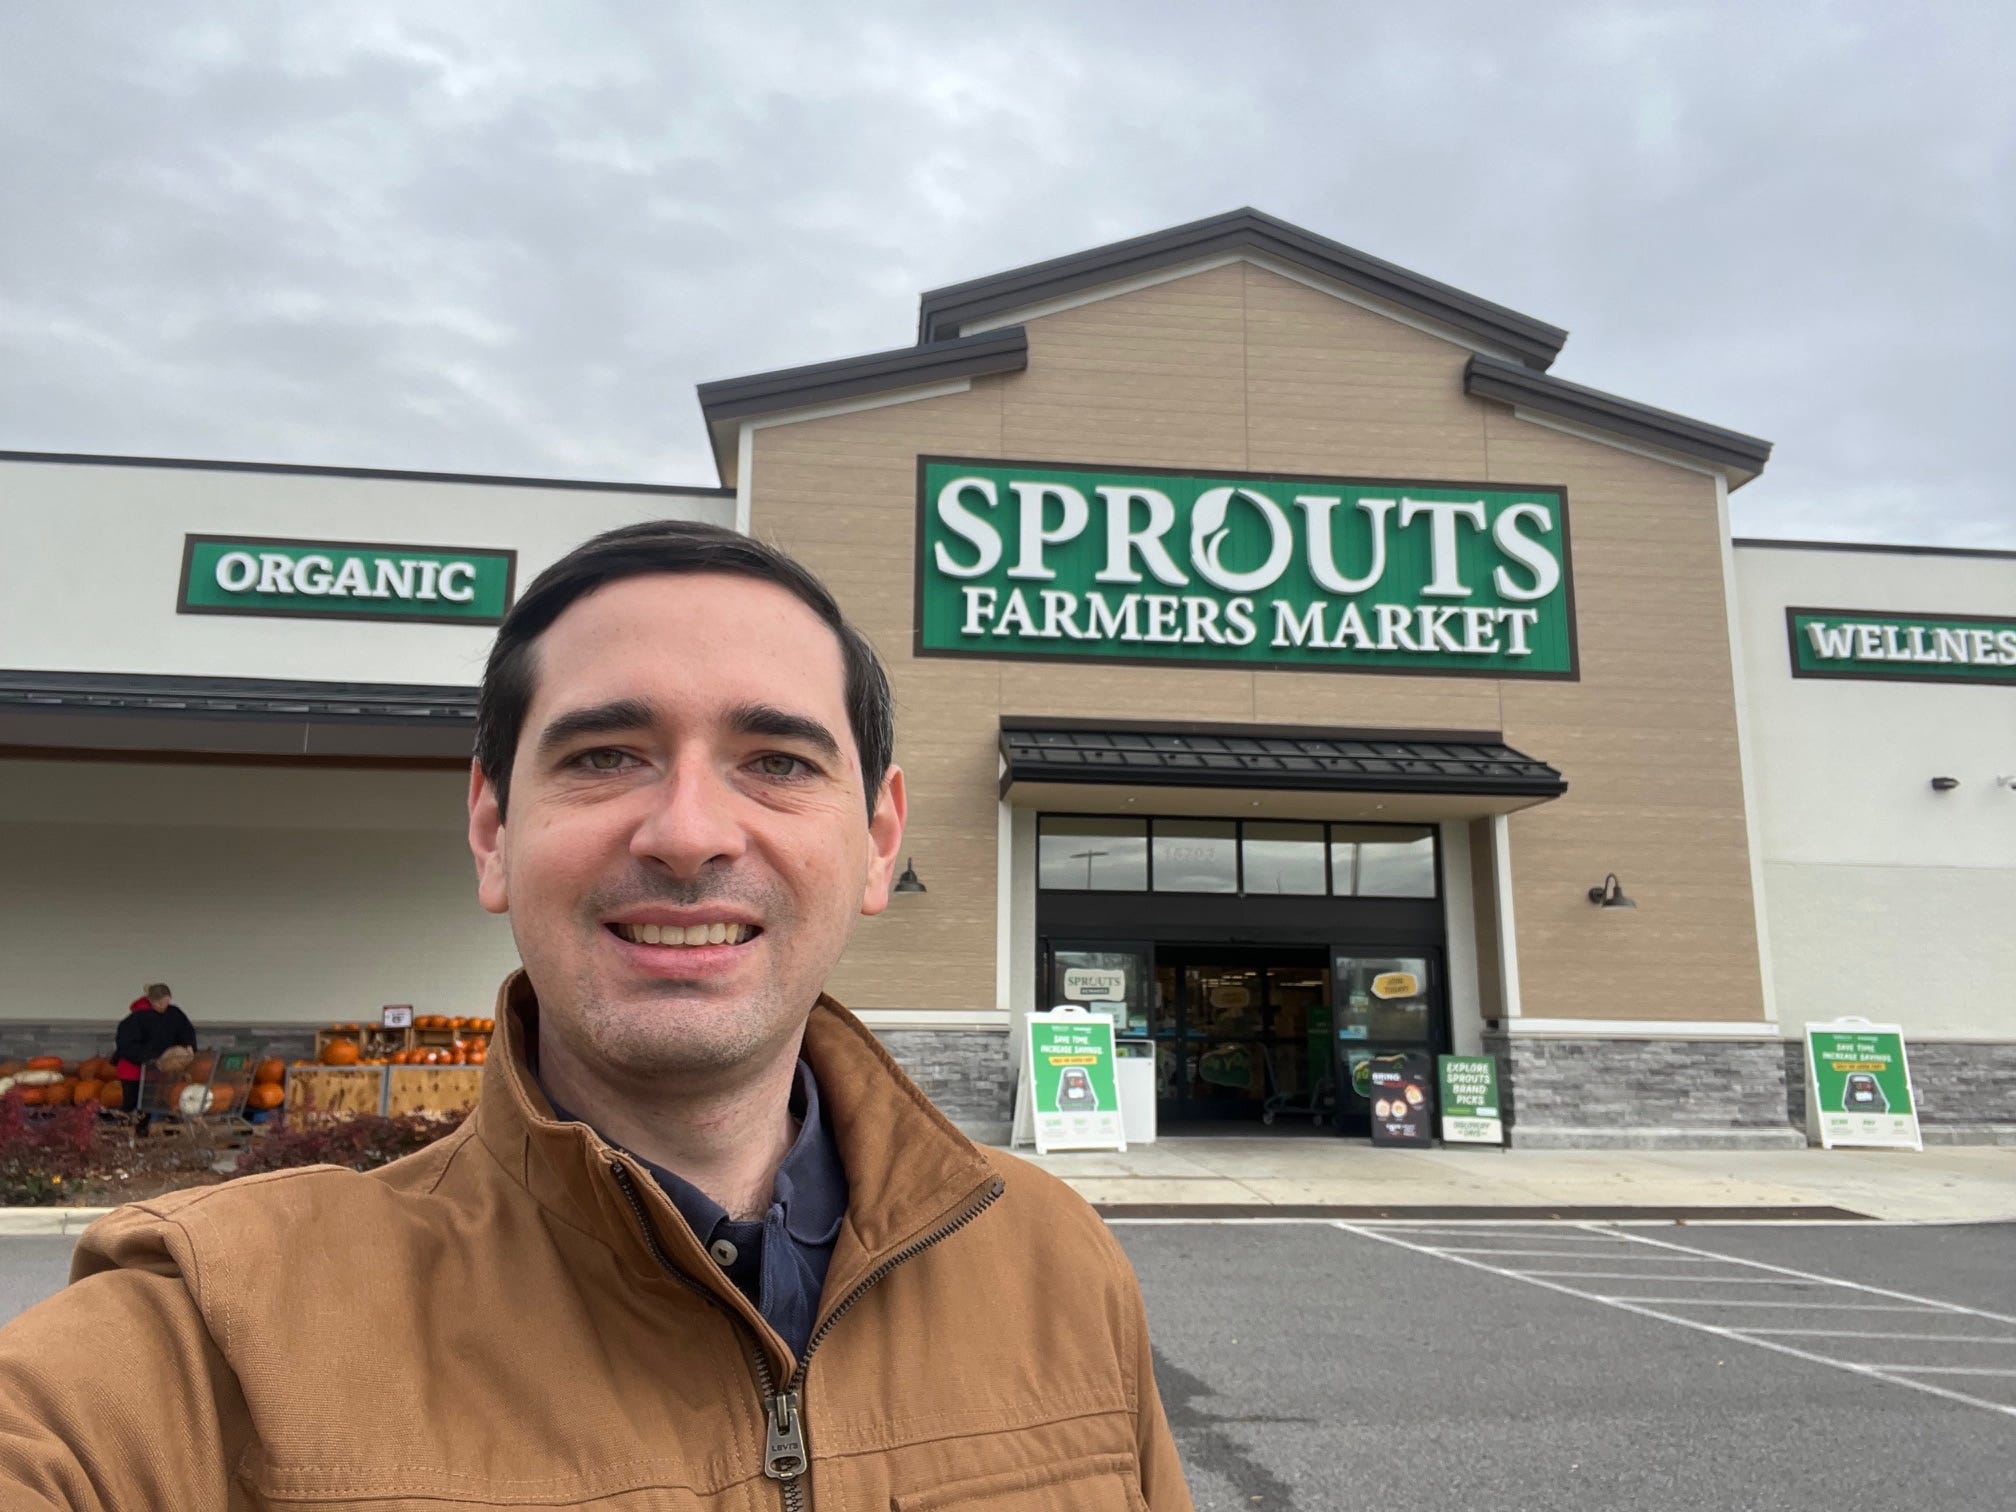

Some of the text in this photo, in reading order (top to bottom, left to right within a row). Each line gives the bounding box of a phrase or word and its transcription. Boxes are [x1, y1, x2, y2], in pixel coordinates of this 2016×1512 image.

[934, 477, 1560, 600] SPROUTS
[215, 551, 476, 602] ORGANIC
[960, 586, 1538, 657] FARMERS MARKET
[1067, 976, 1121, 987] SPROUTS
[1053, 1035, 1089, 1045] SAVE TIME
[1040, 1045, 1072, 1054] INCREASE
[1836, 1043, 1875, 1054] SAVE TIME
[1822, 1051, 1857, 1061] INCREASE
[1446, 1062, 1489, 1074] EXPLORE
[1446, 1073, 1491, 1084] SPROUTS
[1452, 1083, 1488, 1095] BRAND
[1456, 1094, 1485, 1105] PICKS
